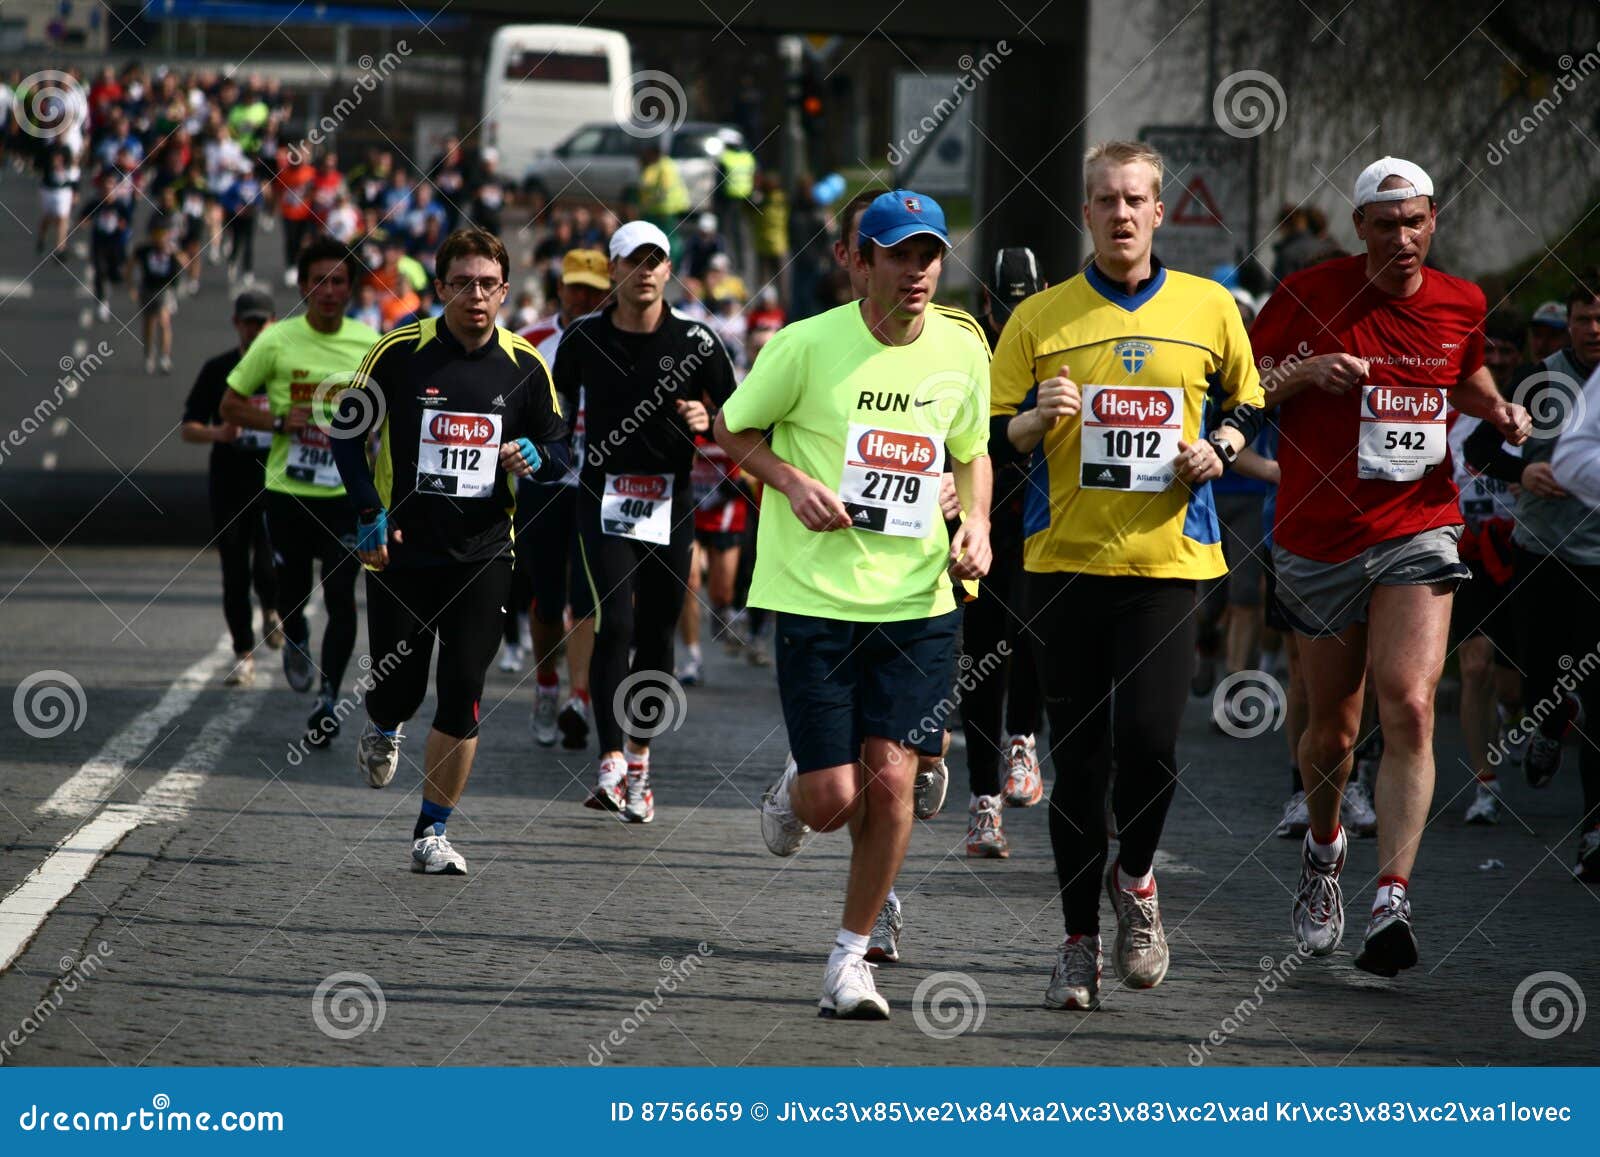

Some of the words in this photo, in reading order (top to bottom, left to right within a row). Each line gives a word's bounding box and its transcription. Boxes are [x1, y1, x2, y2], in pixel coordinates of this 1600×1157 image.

[857, 391, 910, 412] RUN
[1101, 393, 1167, 420] Hervis
[1377, 389, 1438, 416] Hervis
[437, 417, 488, 440] Hervis
[1384, 431, 1425, 450] 542
[866, 433, 931, 465] Hervis
[1103, 430, 1161, 458] 1012
[439, 447, 481, 471] 1112
[862, 471, 921, 504] 2779
[620, 498, 654, 519] 404
